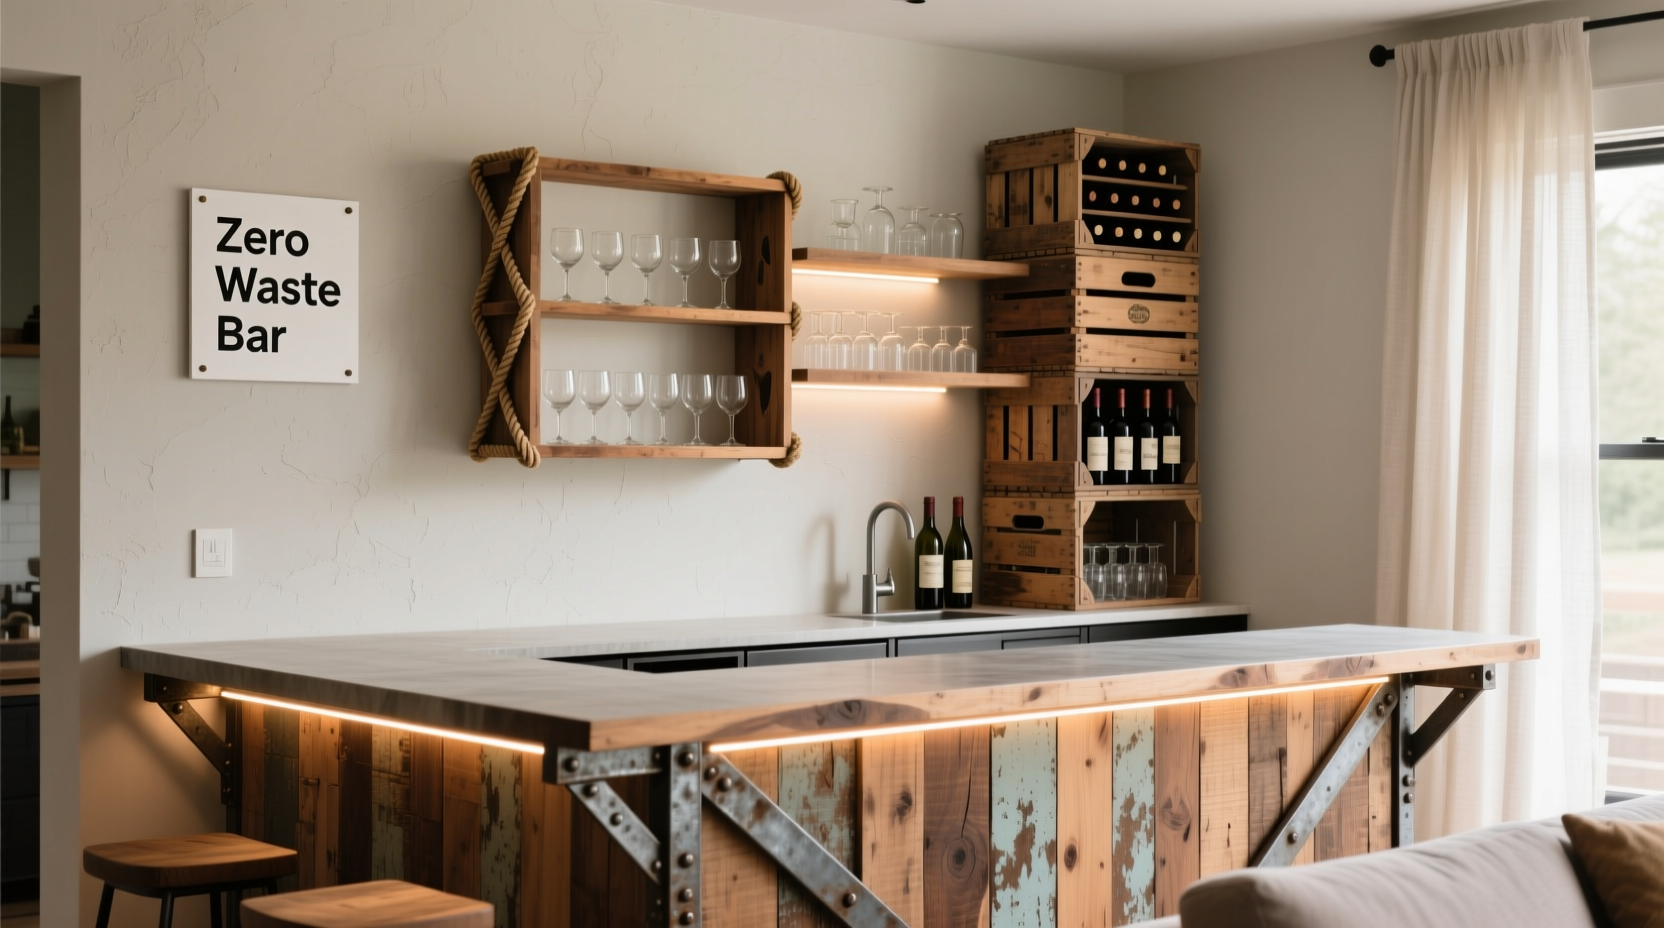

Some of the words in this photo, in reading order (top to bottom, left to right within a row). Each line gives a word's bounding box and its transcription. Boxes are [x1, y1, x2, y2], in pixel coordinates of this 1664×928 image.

[216, 216, 309, 257] Zero
[214, 265, 341, 308] Waste
[217, 315, 287, 353] Bar
